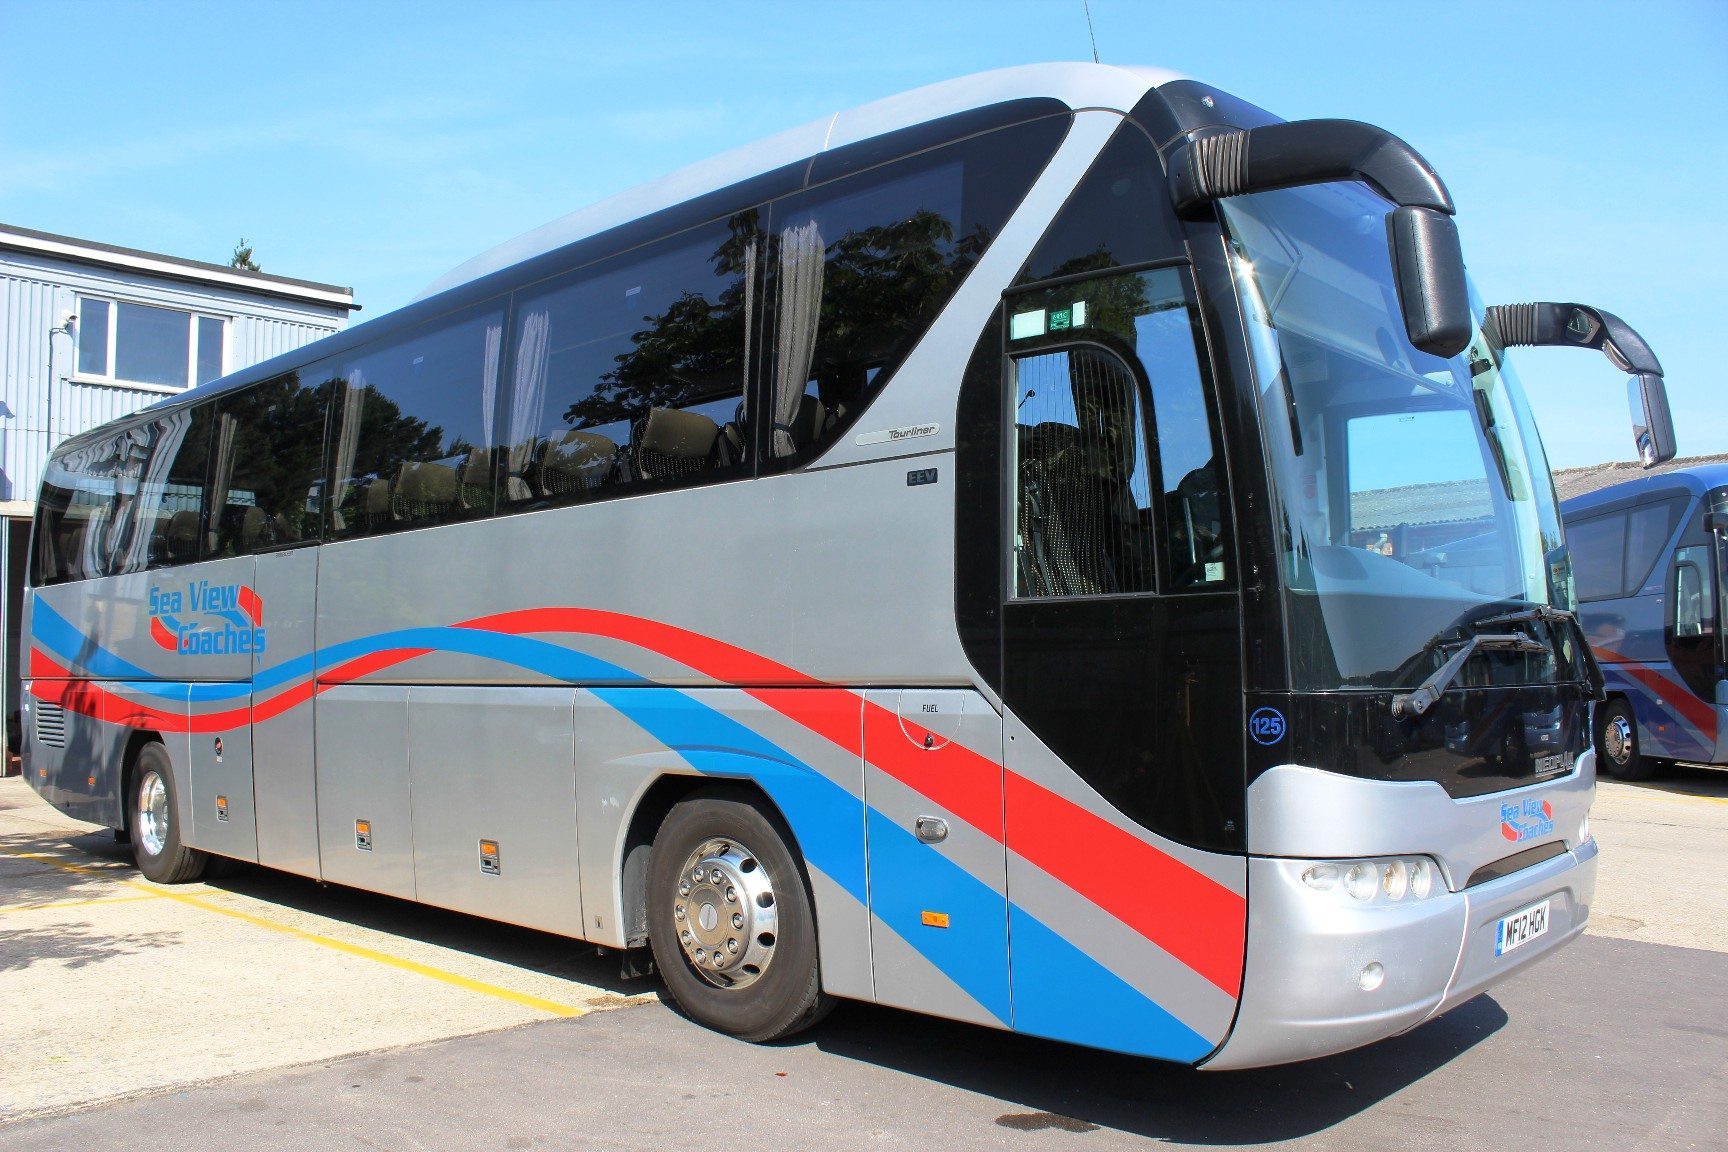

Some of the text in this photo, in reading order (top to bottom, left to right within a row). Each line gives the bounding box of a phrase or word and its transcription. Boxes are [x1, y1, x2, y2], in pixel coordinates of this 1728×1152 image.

[889, 426, 935, 439] Tourliner
[908, 469, 937, 484] EEV
[149, 580, 239, 615] Sea View
[178, 623, 266, 655] Coaches
[922, 704, 938, 712] FUEL
[1253, 718, 1281, 734] 125
[1501, 798, 1543, 821] Sea View
[1518, 820, 1554, 842] Coaches
[1529, 906, 1547, 936] HGK
